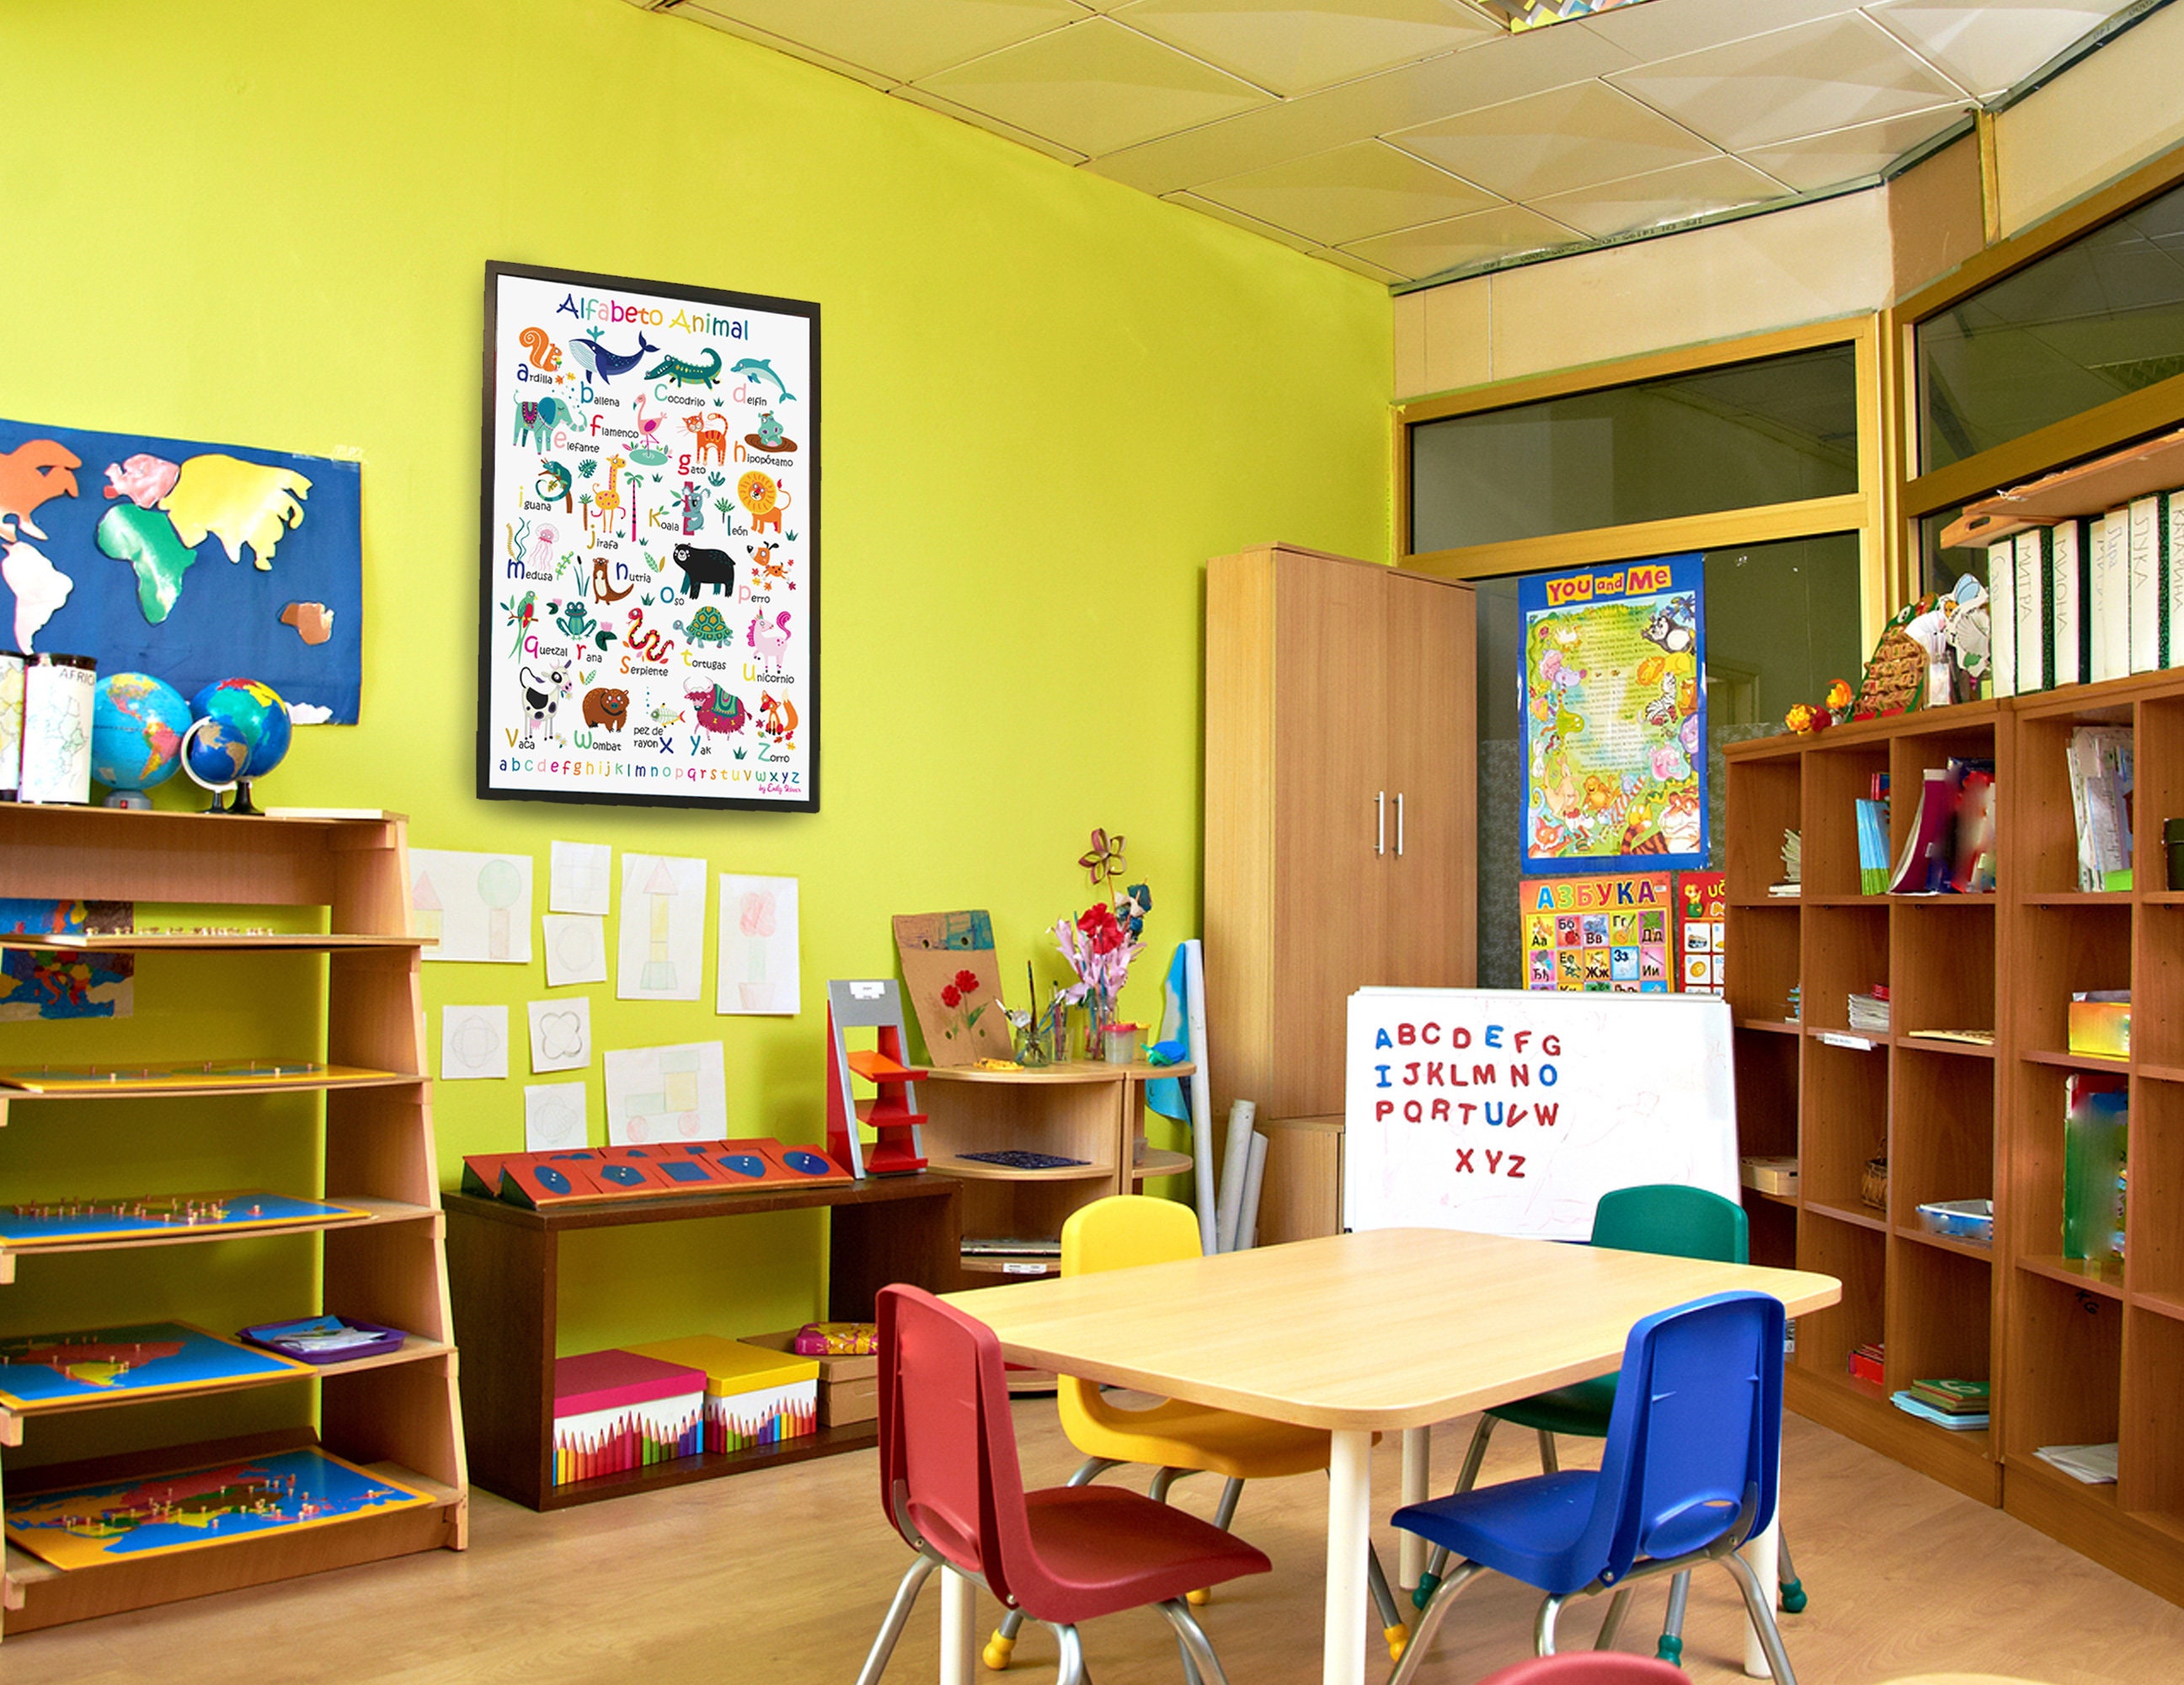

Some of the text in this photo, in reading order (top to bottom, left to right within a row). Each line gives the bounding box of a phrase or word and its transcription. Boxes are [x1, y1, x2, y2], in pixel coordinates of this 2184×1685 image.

[556, 293, 748, 340] Alfabeto Animal
[516, 363, 553, 385] ardilla
[580, 382, 620, 407] ballena
[590, 415, 639, 439] flamenco
[553, 431, 600, 453] elefante
[678, 453, 707, 476] gato
[518, 485, 552, 511] iguana
[586, 524, 619, 550] jirafa
[507, 559, 553, 581] medusa
[616, 562, 651, 584] nutria
[1597, 576, 1622, 591] and
[1629, 570, 1668, 591] Me
[738, 585, 771, 604] perro
[576, 643, 603, 664] rana
[681, 648, 727, 671] tortugas
[633, 726, 664, 736] pez de
[1537, 880, 1656, 909] АЗБУКА
